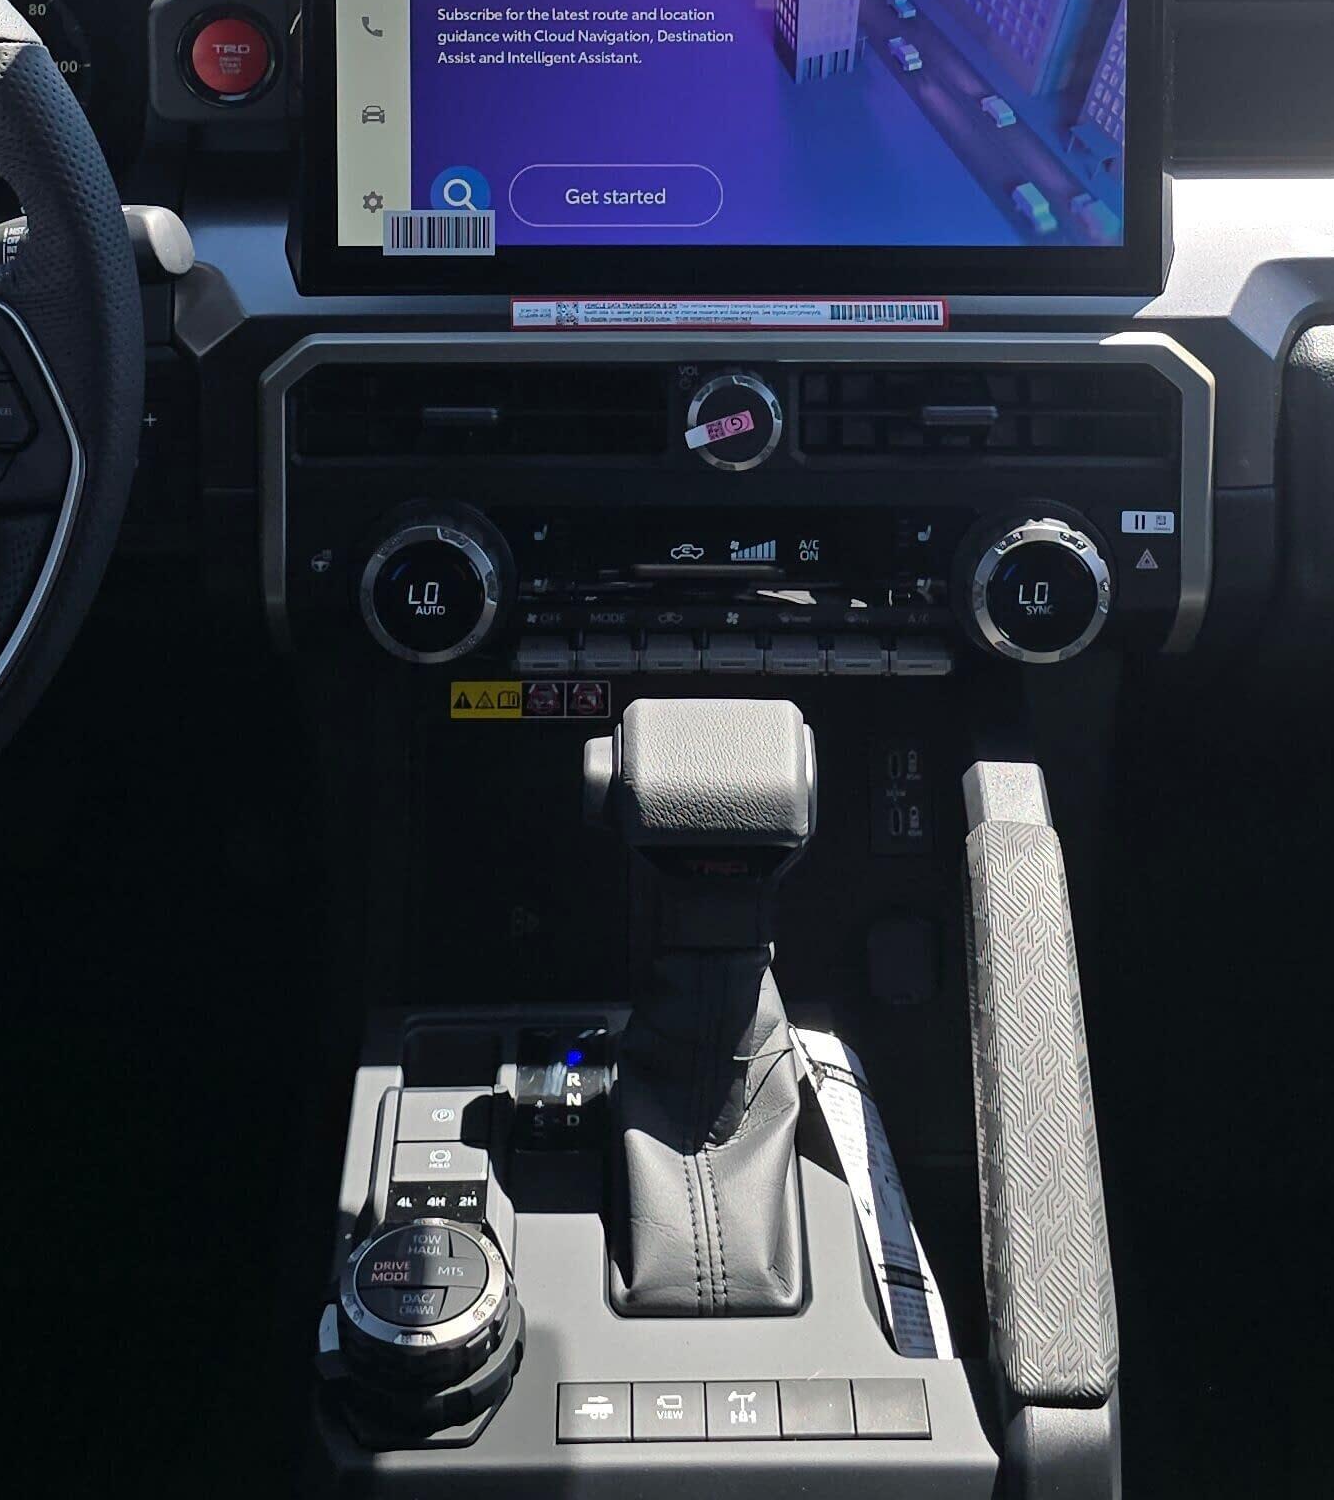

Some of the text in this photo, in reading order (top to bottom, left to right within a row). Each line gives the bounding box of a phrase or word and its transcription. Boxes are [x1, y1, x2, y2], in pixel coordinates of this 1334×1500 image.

[28, 2, 47, 17] 80
[437, 8, 715, 21] Subscribe for the latest route and location
[437, 29, 734, 45] guidance with Cloud Navigation, Destination
[212, 43, 250, 54] TRD
[437, 51, 643, 67] Assist and Intelligent Assistant.
[58, 60, 79, 74] 00
[565, 187, 667, 205] Get started
[678, 364, 699, 376] VOL
[798, 539, 820, 550] A/C
[799, 550, 820, 562] ON
[407, 581, 441, 606] LO
[1017, 581, 1050, 606] LO
[414, 605, 446, 617] AUTO
[1025, 605, 1053, 617] SYNC
[589, 612, 628, 624] MODE
[567, 1072, 582, 1087] R
[567, 1092, 582, 1107] N
[567, 1114, 580, 1126] D
[396, 1196, 478, 1208] 4L 4H 2H
[408, 1245, 442, 1256] HAUL
[373, 1261, 411, 1272] DRIVE
[437, 1266, 464, 1277] MTS
[371, 1272, 410, 1282] MODE
[402, 1293, 436, 1304] DAC/
[399, 1305, 436, 1315] CRAWL
[656, 1410, 684, 1420] VIEW
